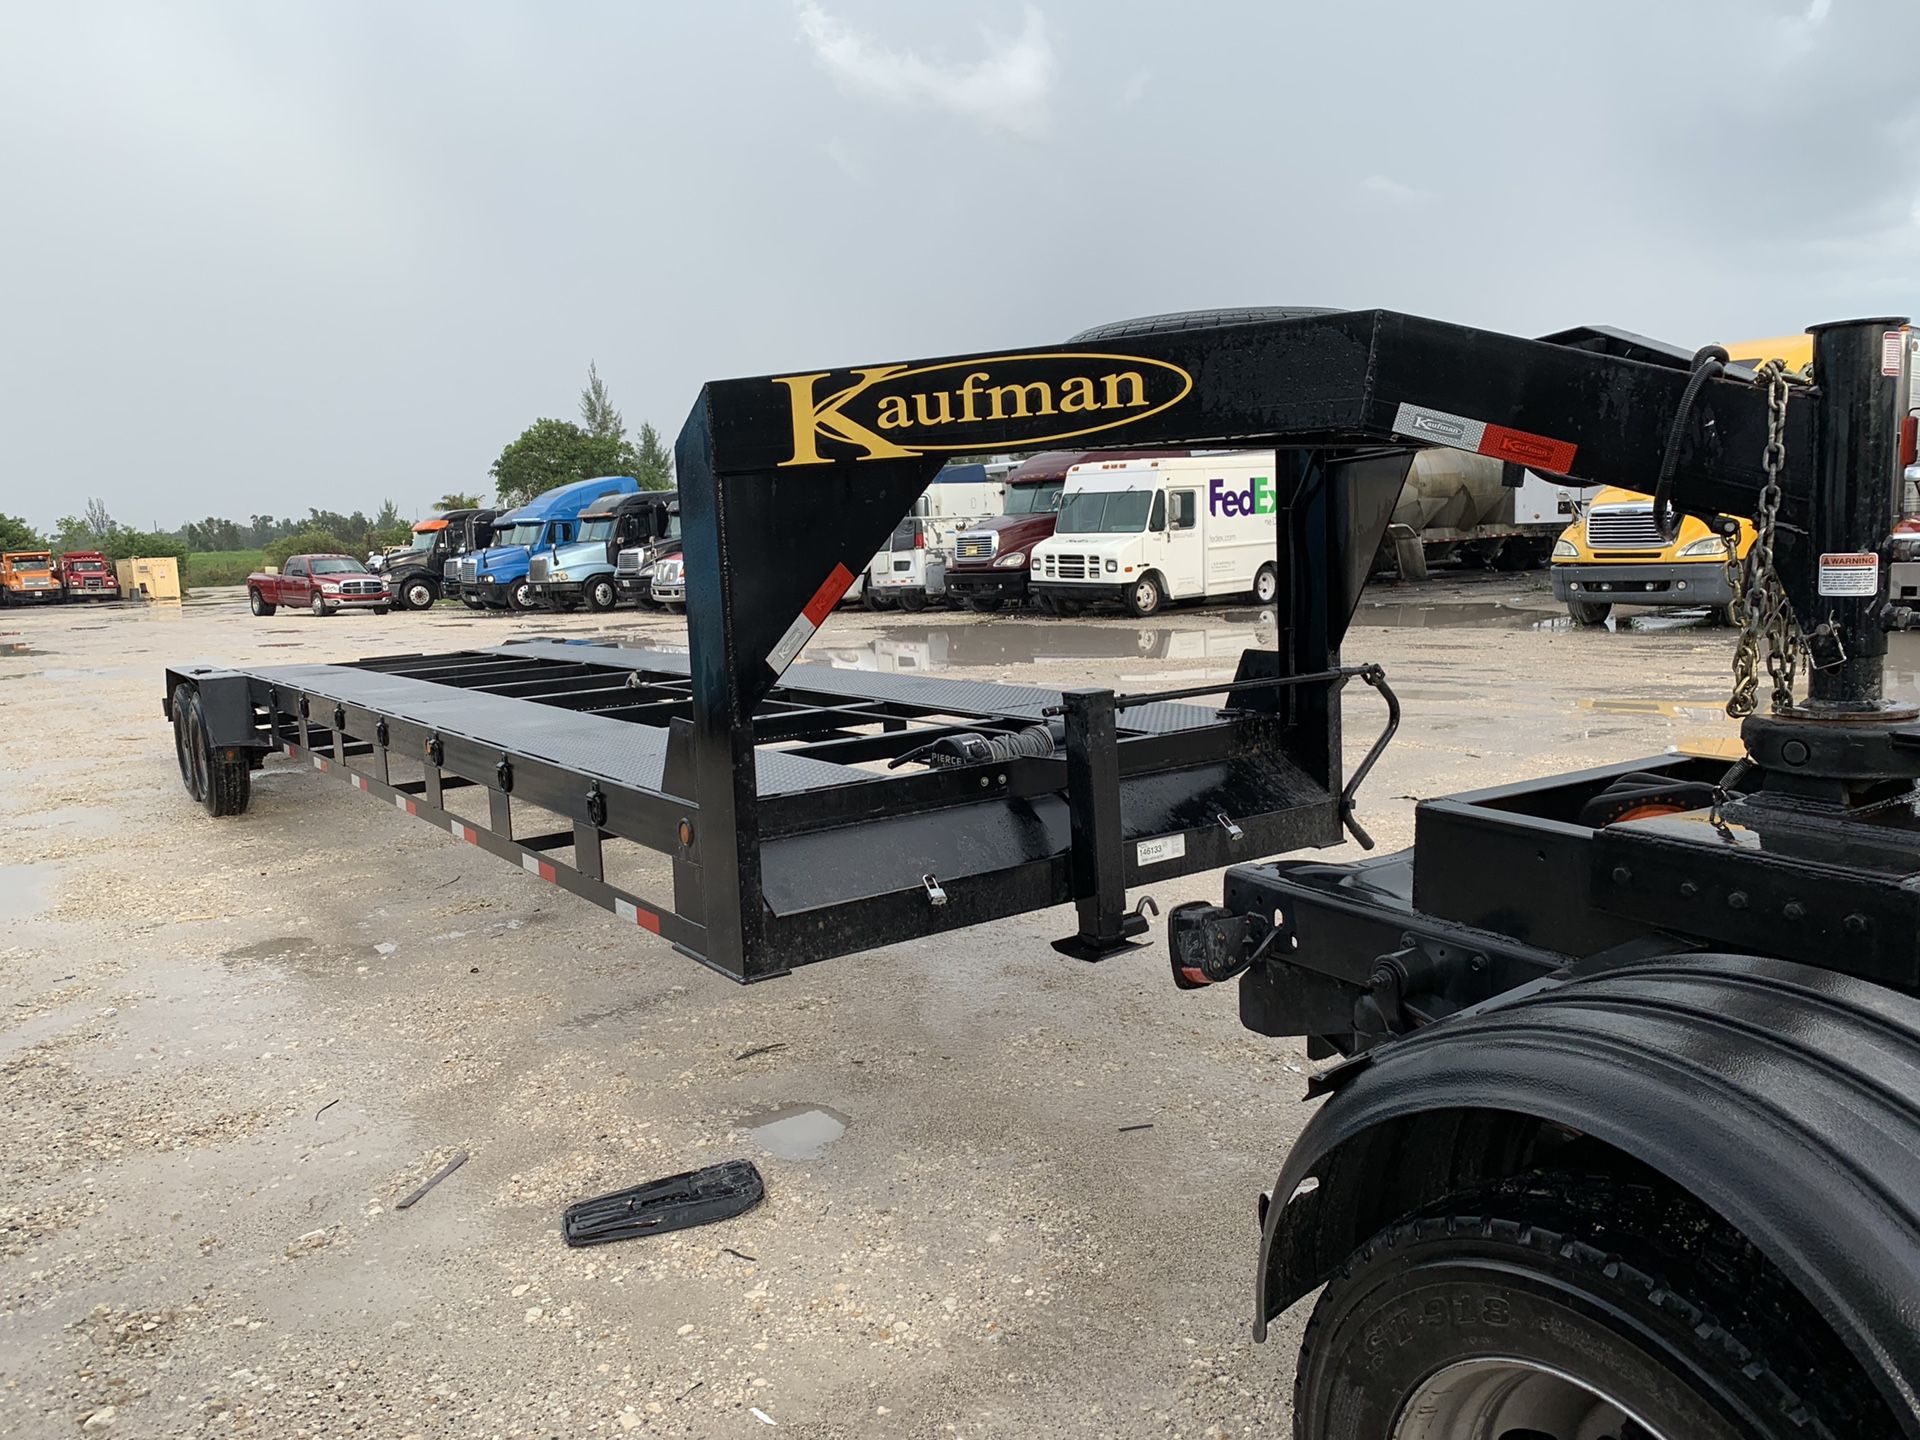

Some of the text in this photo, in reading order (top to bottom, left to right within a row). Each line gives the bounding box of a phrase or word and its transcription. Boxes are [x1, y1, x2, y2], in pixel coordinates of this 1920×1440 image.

[772, 364, 1149, 467] Kaufman
[1413, 416, 1460, 435] Kaufman
[1501, 437, 1549, 457] Kaufman
[1831, 557, 1874, 565] WARNING
[931, 752, 962, 765] PIERCE
